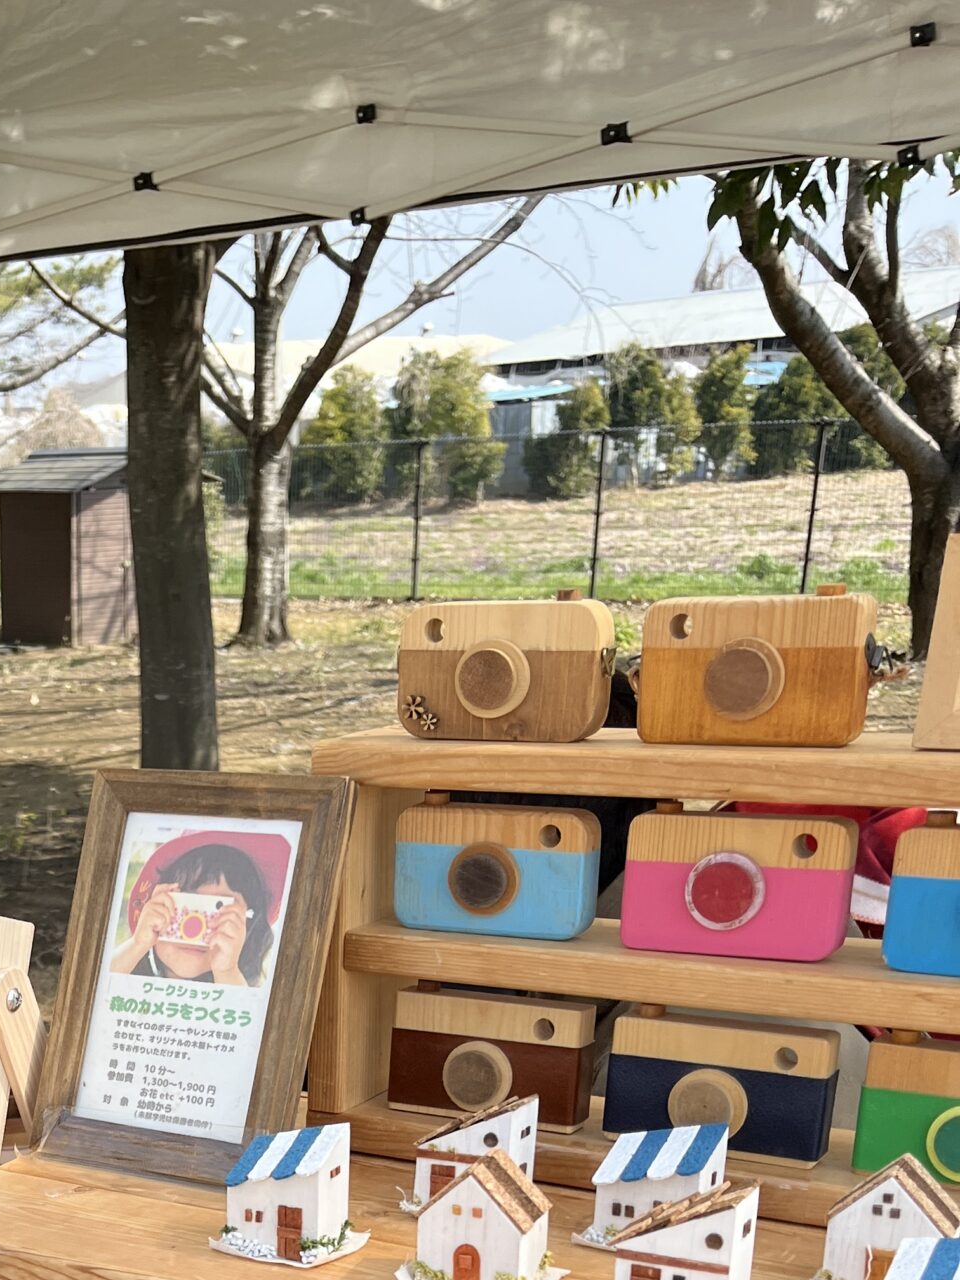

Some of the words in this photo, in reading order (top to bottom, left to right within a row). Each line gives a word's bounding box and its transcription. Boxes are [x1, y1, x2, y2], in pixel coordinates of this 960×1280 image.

[142, 982, 224, 1002] ワークショップ
[109, 995, 252, 1028] 森のカメラをつくろう
